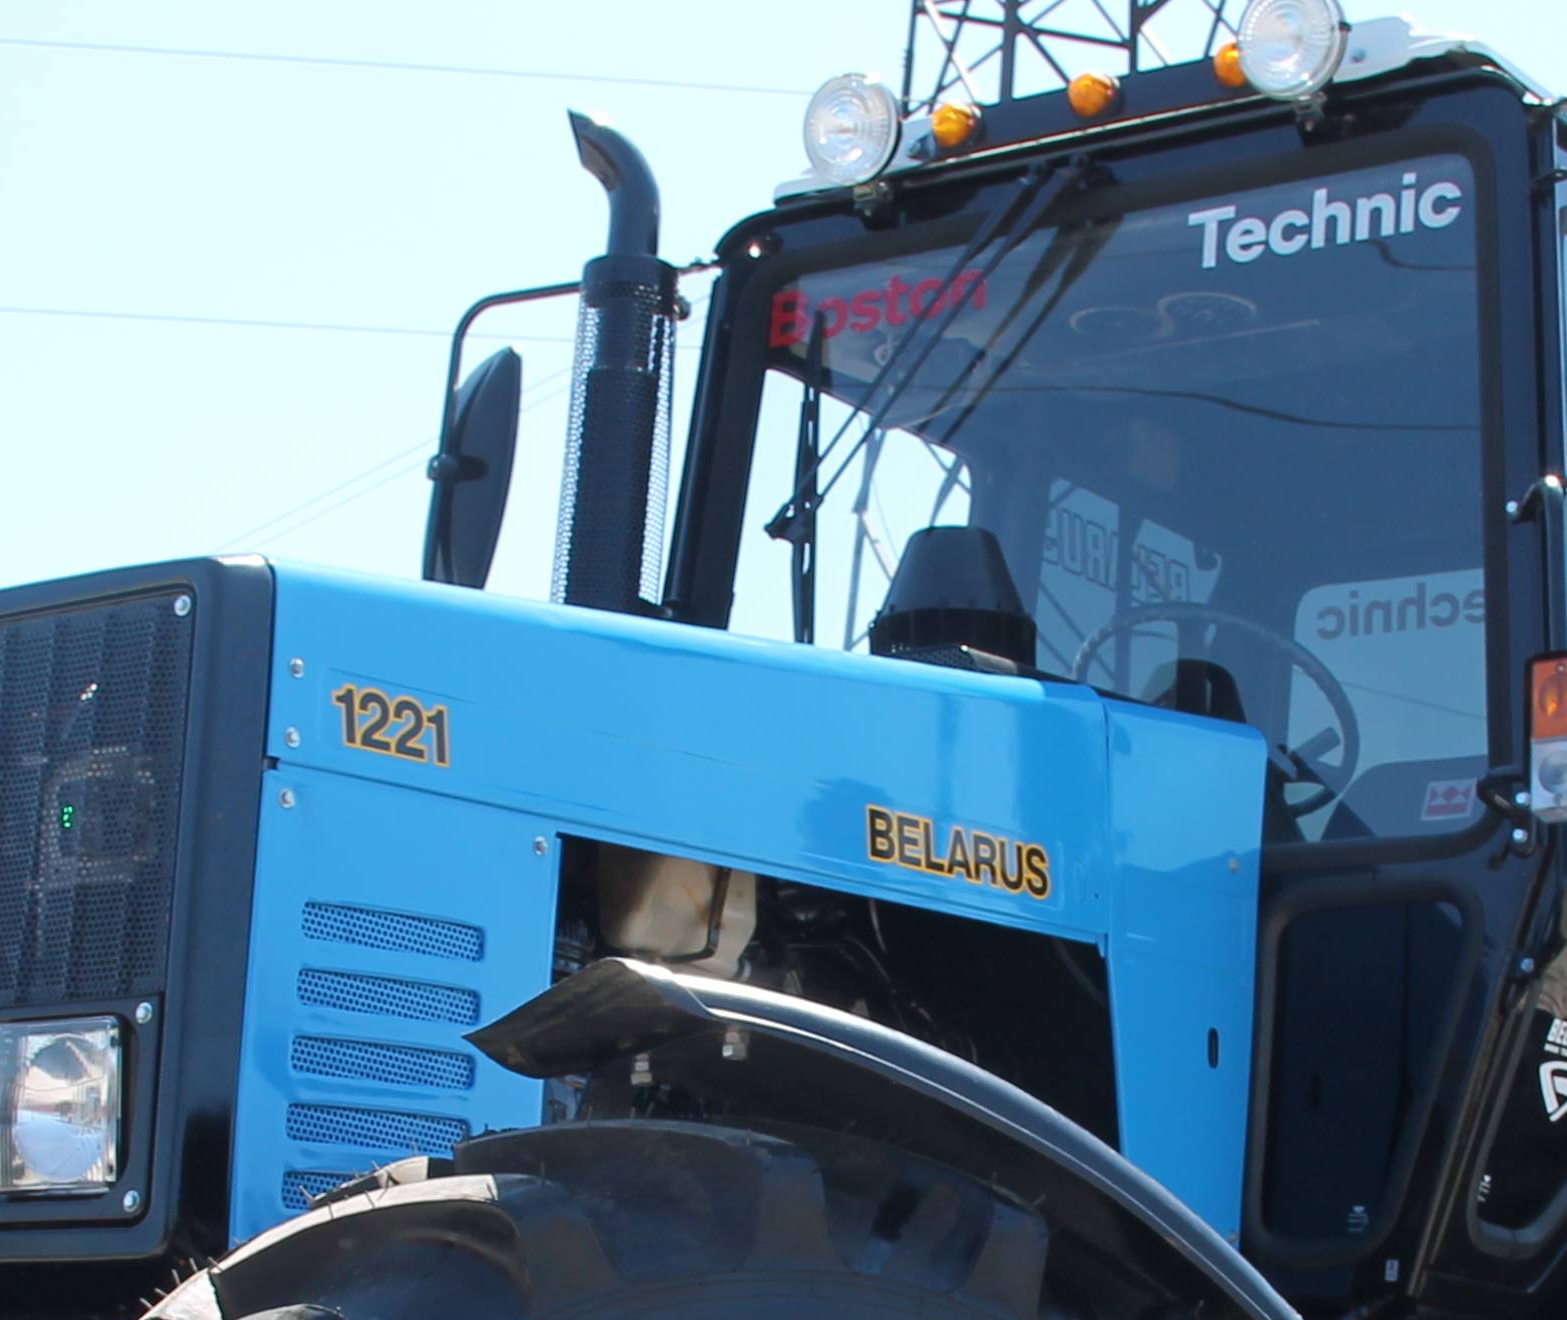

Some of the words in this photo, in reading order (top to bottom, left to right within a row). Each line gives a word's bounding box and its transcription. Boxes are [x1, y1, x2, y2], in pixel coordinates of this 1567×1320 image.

[1187, 173, 1462, 269] Technic
[770, 269, 987, 348] Boston
[332, 682, 451, 768] 1221
[866, 804, 1052, 902] BELARUS
